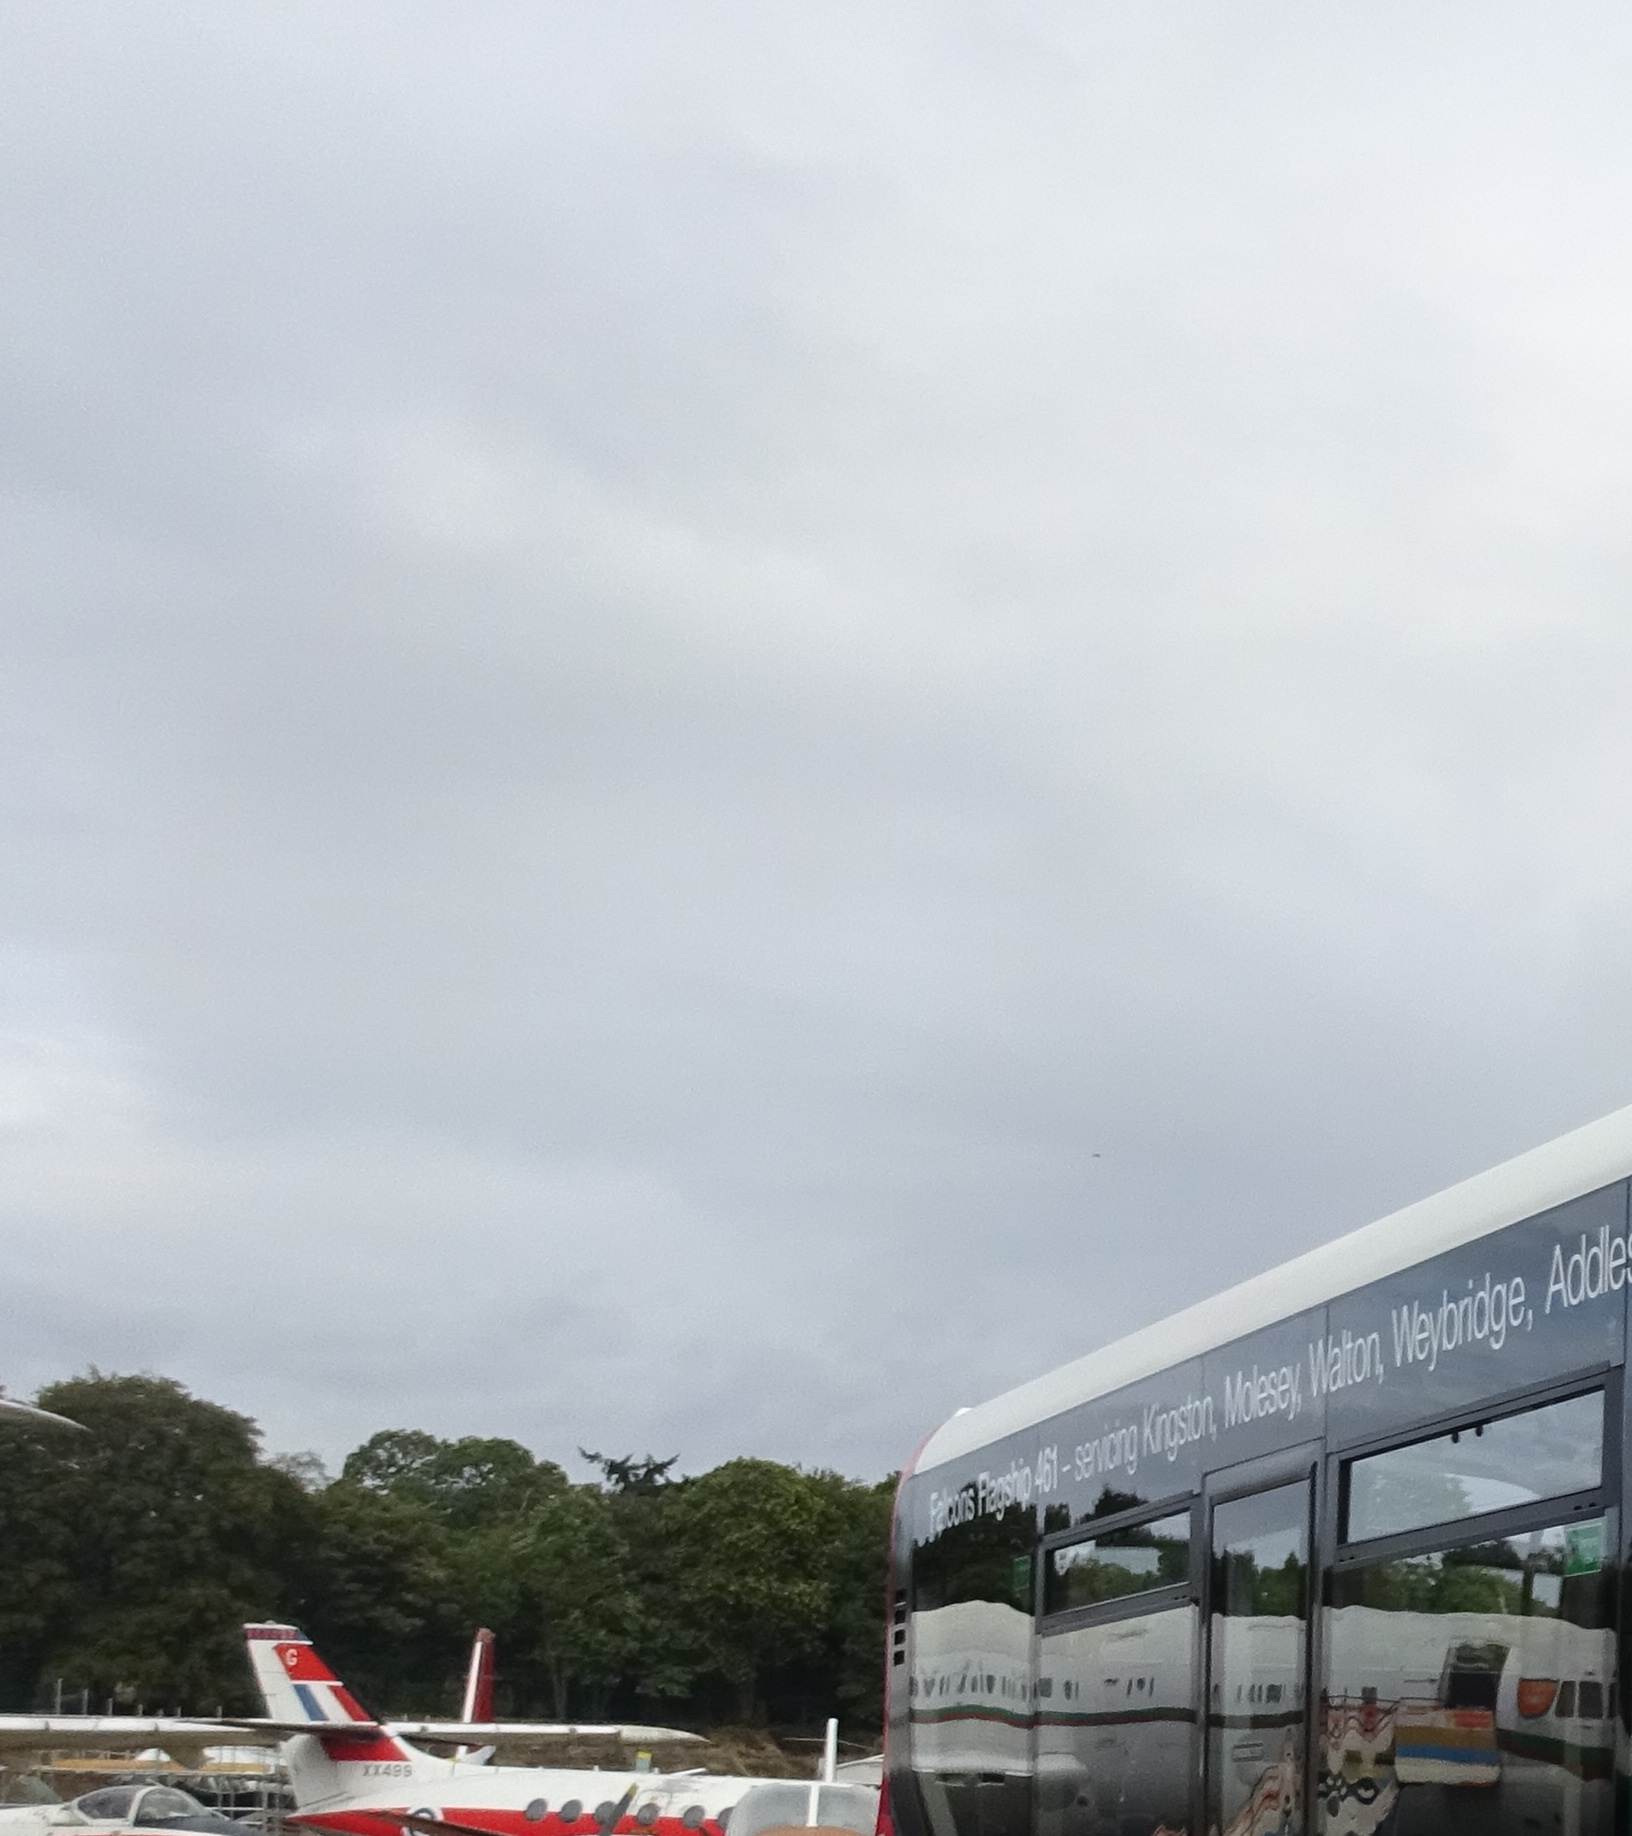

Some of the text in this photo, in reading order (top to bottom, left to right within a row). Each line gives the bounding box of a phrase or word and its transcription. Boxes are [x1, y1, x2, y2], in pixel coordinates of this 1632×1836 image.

[1034, 1443, 1059, 1494] 461
[1074, 1419, 1138, 1482] servicing
[1143, 1394, 1217, 1461] Kingston,
[1309, 1329, 1384, 1397] Walton,
[1391, 1272, 1533, 1371] Weybridge,
